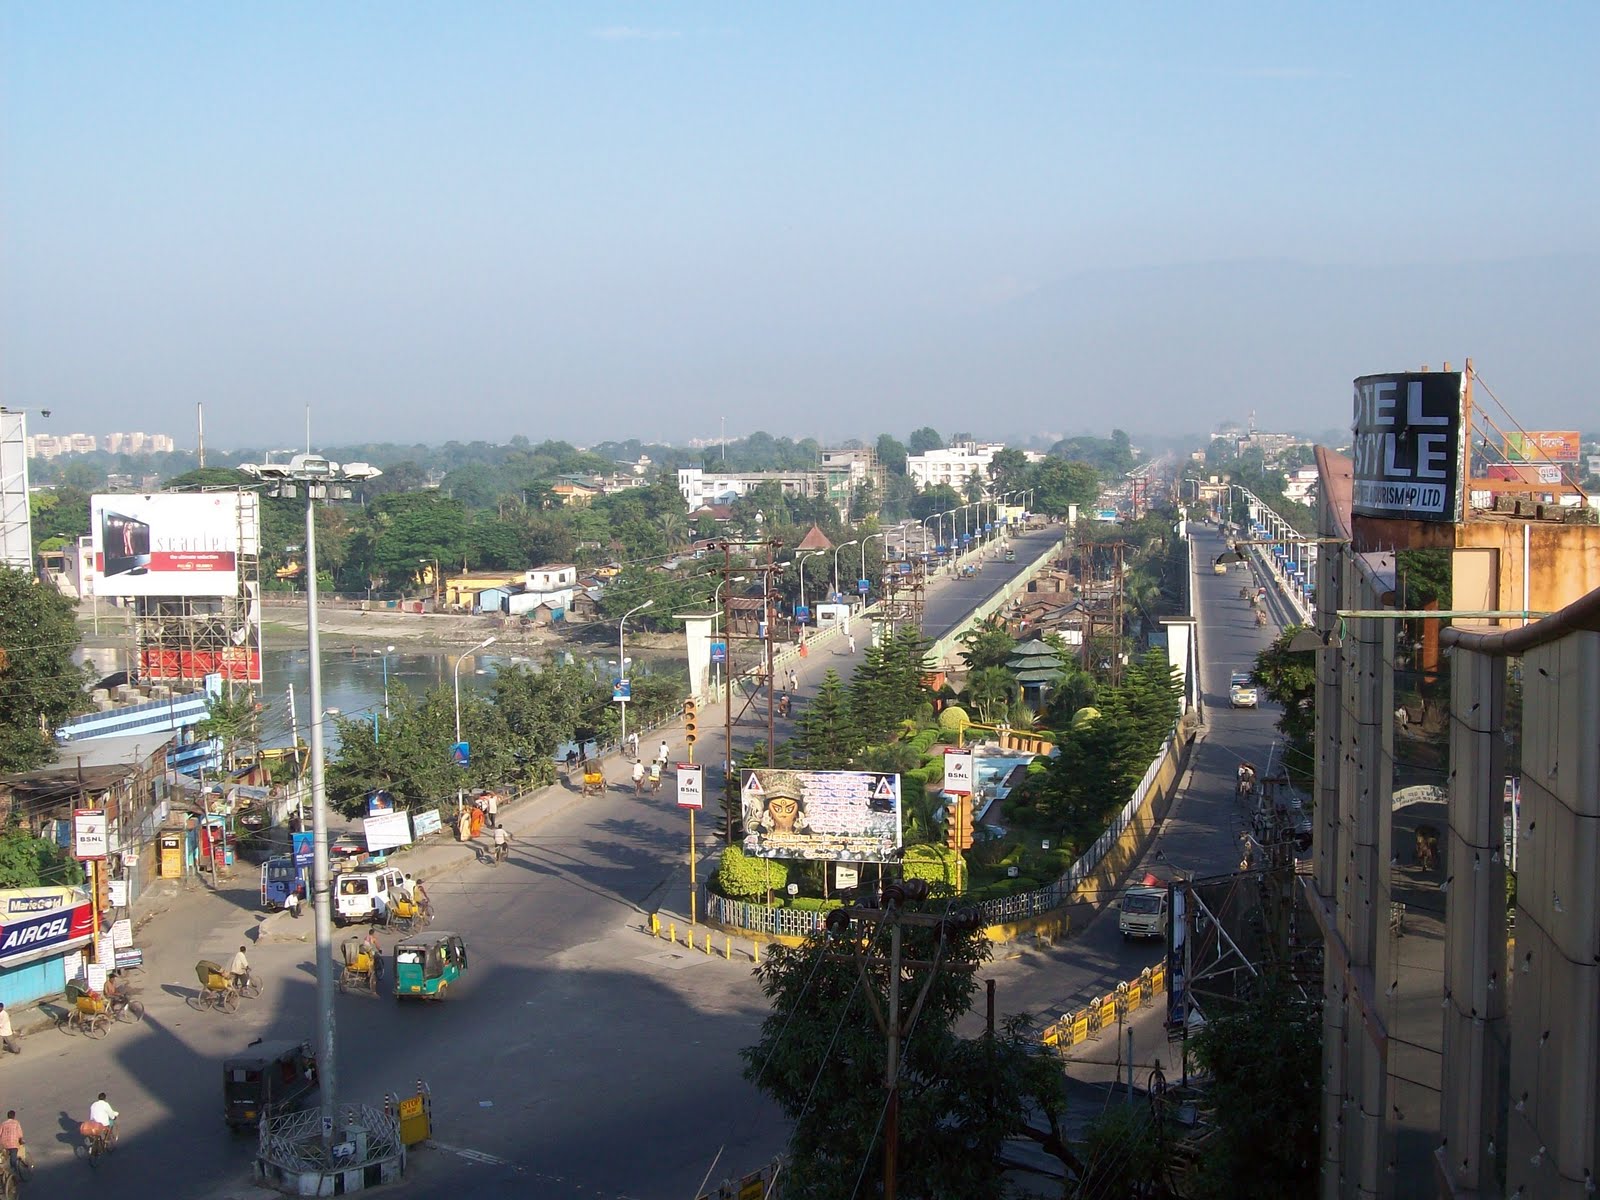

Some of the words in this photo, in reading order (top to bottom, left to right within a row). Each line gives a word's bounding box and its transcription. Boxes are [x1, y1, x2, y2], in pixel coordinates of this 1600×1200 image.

[1422, 488, 1441, 507] LTD.
[2, 917, 68, 950] AIRCEL
[402, 1097, 420, 1110] STOP
